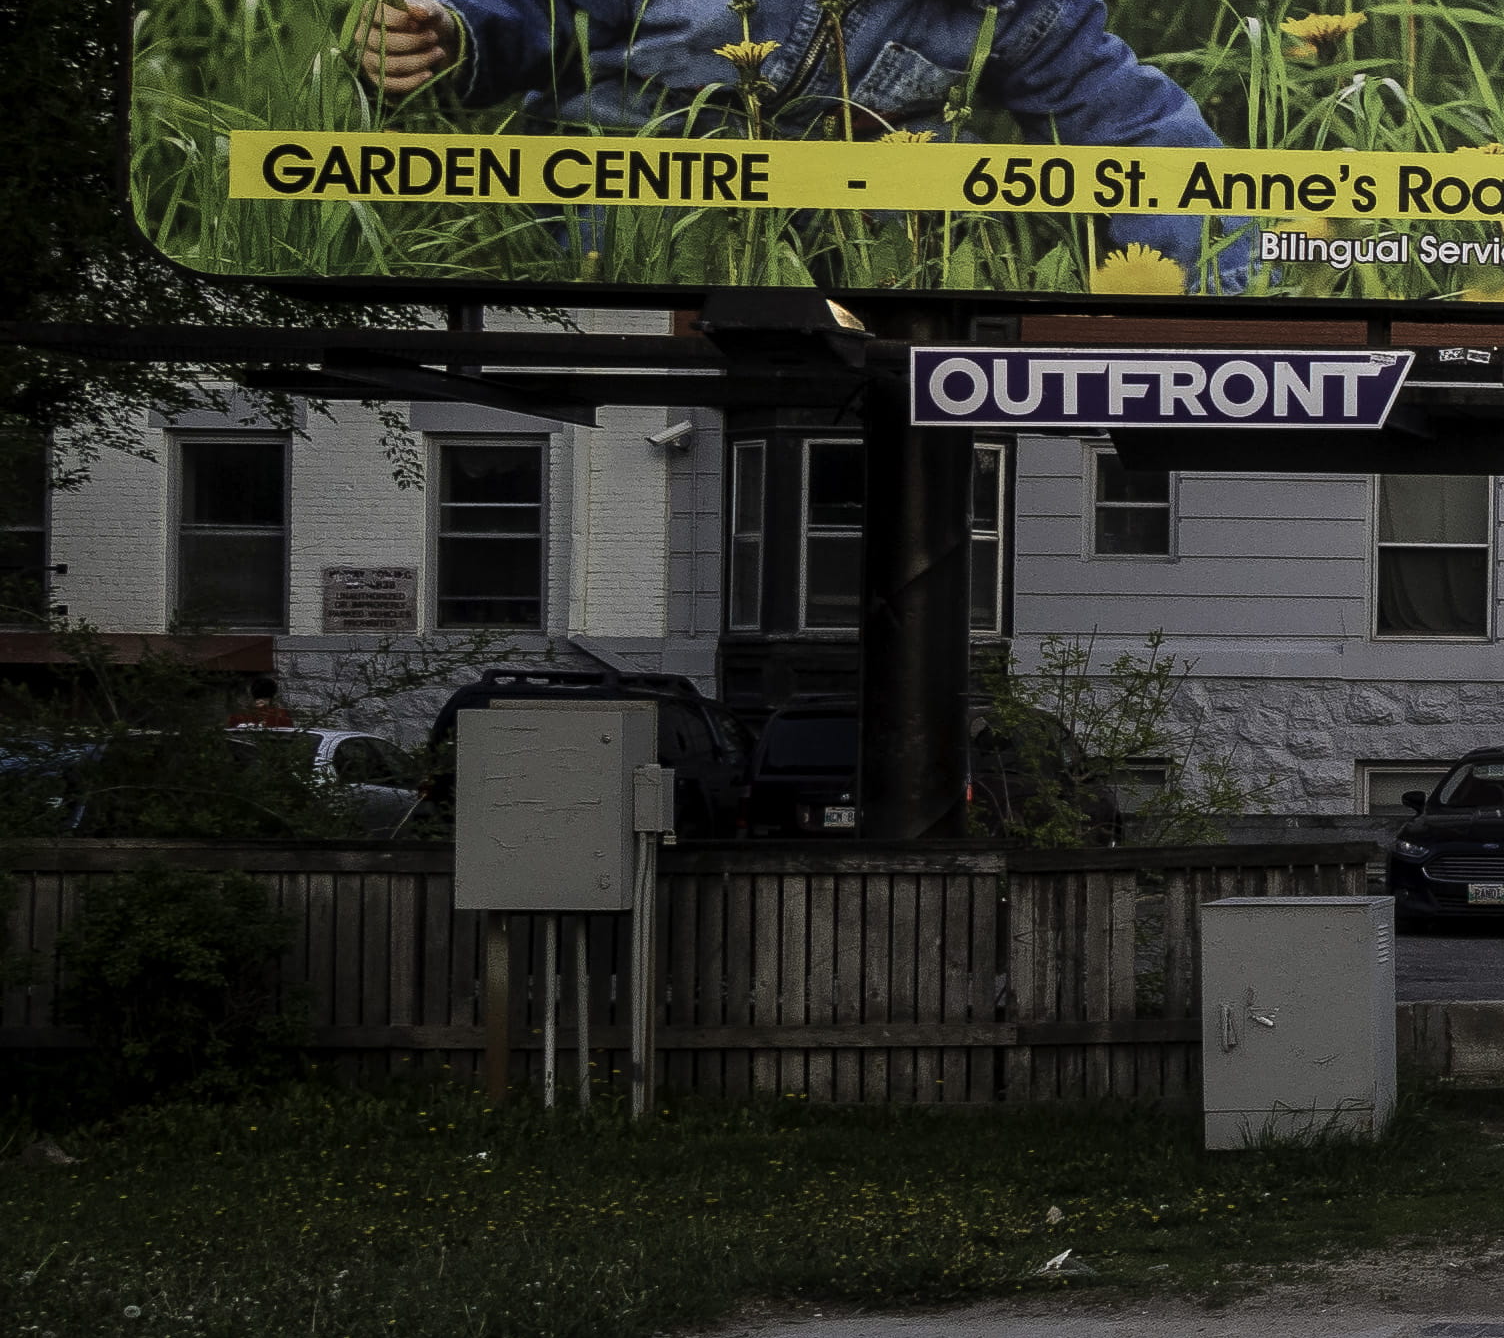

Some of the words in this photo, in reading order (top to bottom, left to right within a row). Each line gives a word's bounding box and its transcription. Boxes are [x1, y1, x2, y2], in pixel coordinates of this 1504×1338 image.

[262, 144, 521, 198] GARDEN
[542, 148, 769, 202] CENTRE
[962, 157, 1076, 208] 650
[1094, 159, 1158, 209] St.
[1178, 160, 1377, 213] Anne's
[1260, 230, 1408, 271] Bilingual
[928, 357, 1386, 418] OUTFRONT
